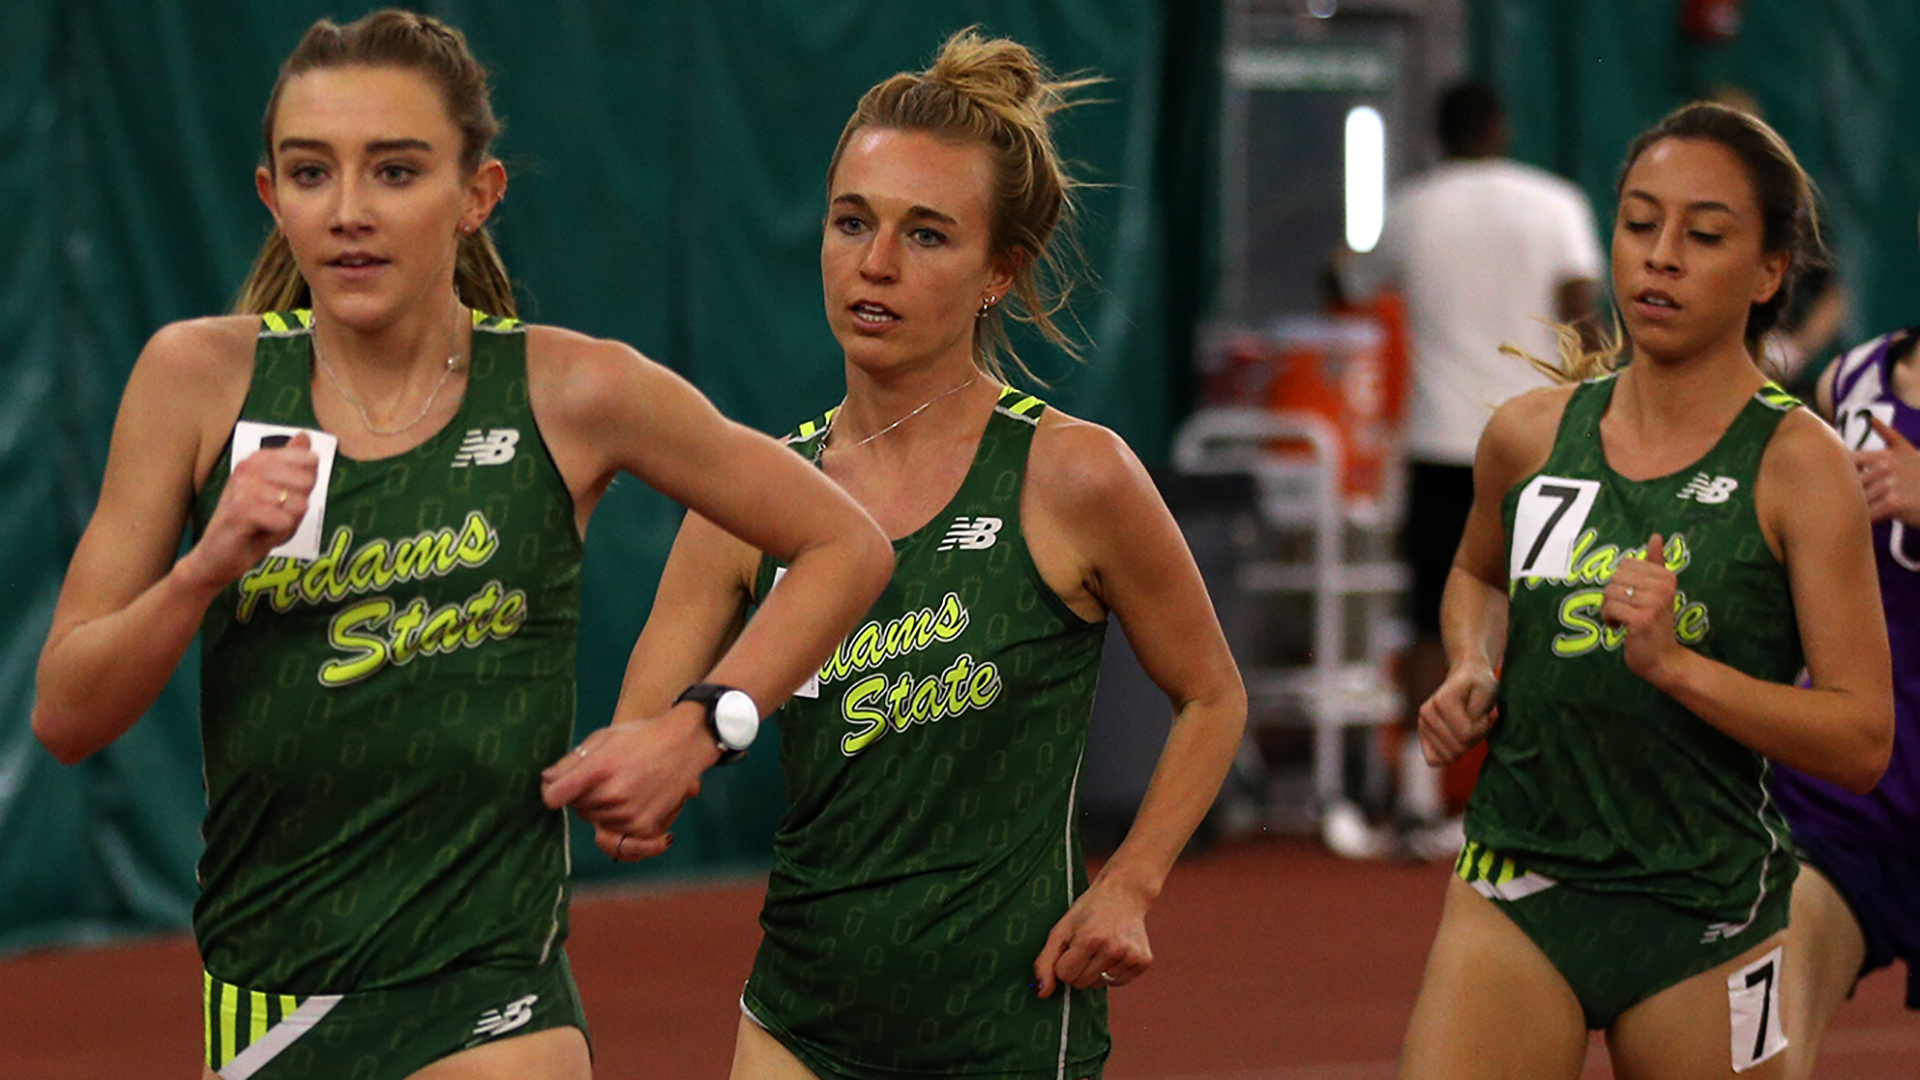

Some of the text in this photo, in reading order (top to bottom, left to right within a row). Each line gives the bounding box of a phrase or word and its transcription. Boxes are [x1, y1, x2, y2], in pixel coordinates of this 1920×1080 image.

[1521, 484, 1581, 572] 7
[318, 580, 527, 687] State
[841, 654, 1002, 756] State
[1745, 960, 1774, 1062] 7
